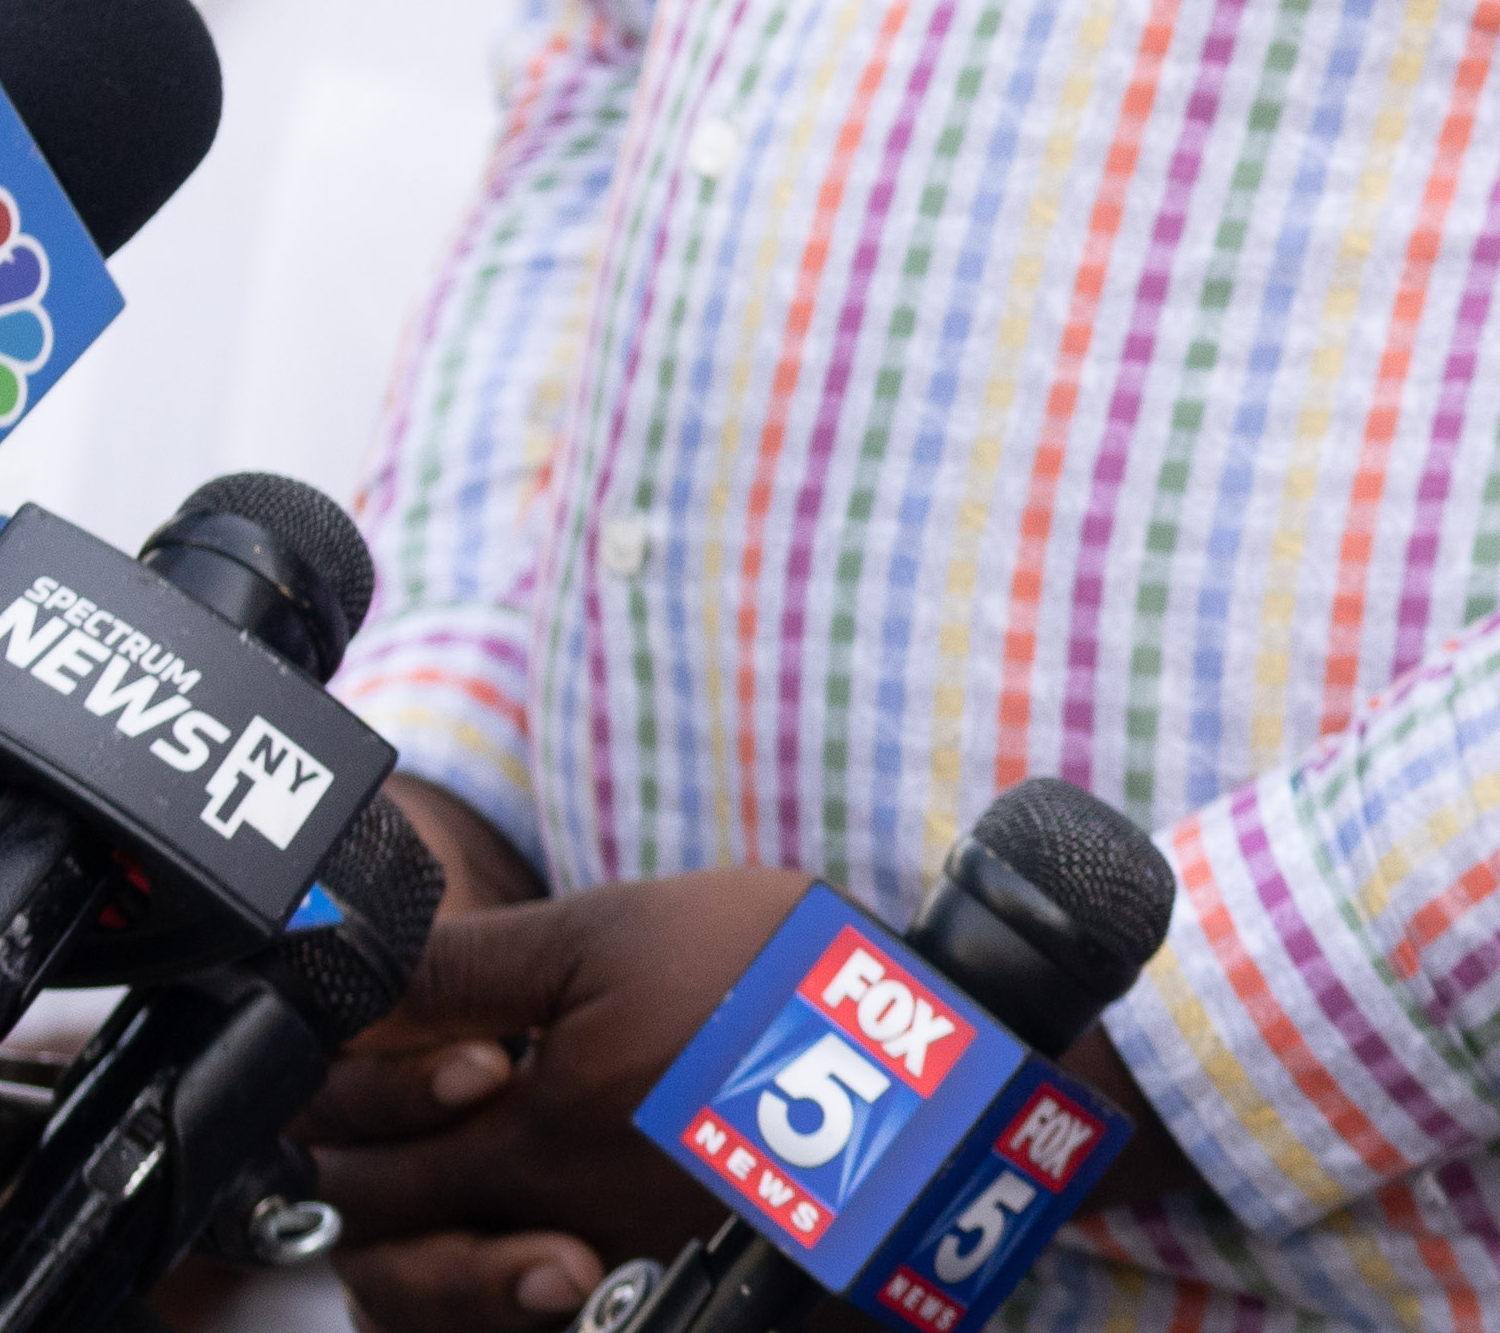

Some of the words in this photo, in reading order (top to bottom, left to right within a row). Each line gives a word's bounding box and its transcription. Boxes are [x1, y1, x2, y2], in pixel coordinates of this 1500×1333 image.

[23, 576, 202, 694] SPECTRUM
[248, 733, 319, 795] NY
[822, 947, 955, 1078] FOX
[757, 1032, 891, 1168] 5
[1009, 1095, 1094, 1179] FOX
[695, 1121, 820, 1234] NEWS
[934, 1170, 1037, 1283] 5
[886, 1275, 957, 1332] NEWS
